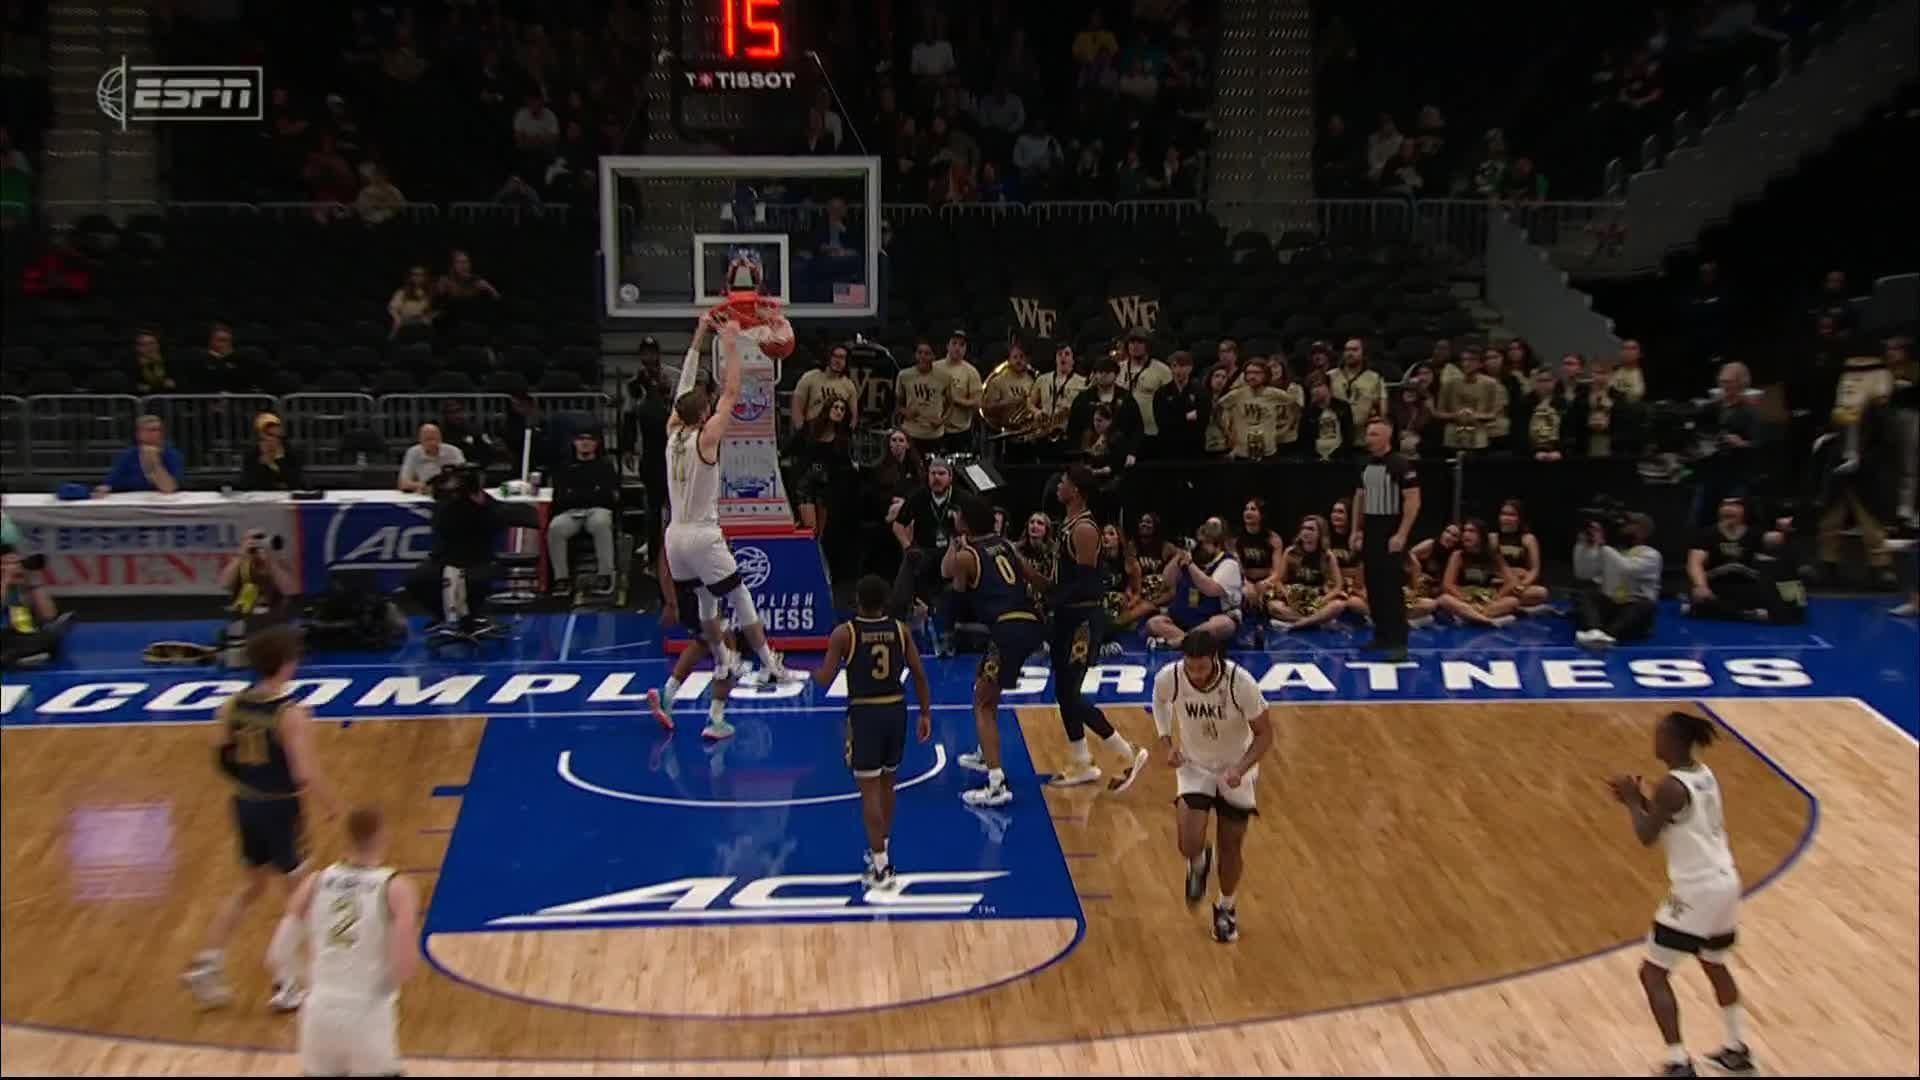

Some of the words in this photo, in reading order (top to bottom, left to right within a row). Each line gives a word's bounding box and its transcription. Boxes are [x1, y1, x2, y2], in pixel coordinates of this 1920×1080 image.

[723, 0, 783, 59] 15
[715, 71, 796, 89] TISSOT
[1009, 297, 1057, 338] WF
[1108, 296, 1160, 333] WF
[56, 524, 242, 551] BASKETBALL
[341, 525, 433, 561] AC
[38, 553, 243, 586] AMENT
[995, 554, 1016, 585] 0
[756, 592, 814, 608] PLISH
[872, 644, 890, 680] 3
[484, 871, 1012, 924] ACC
